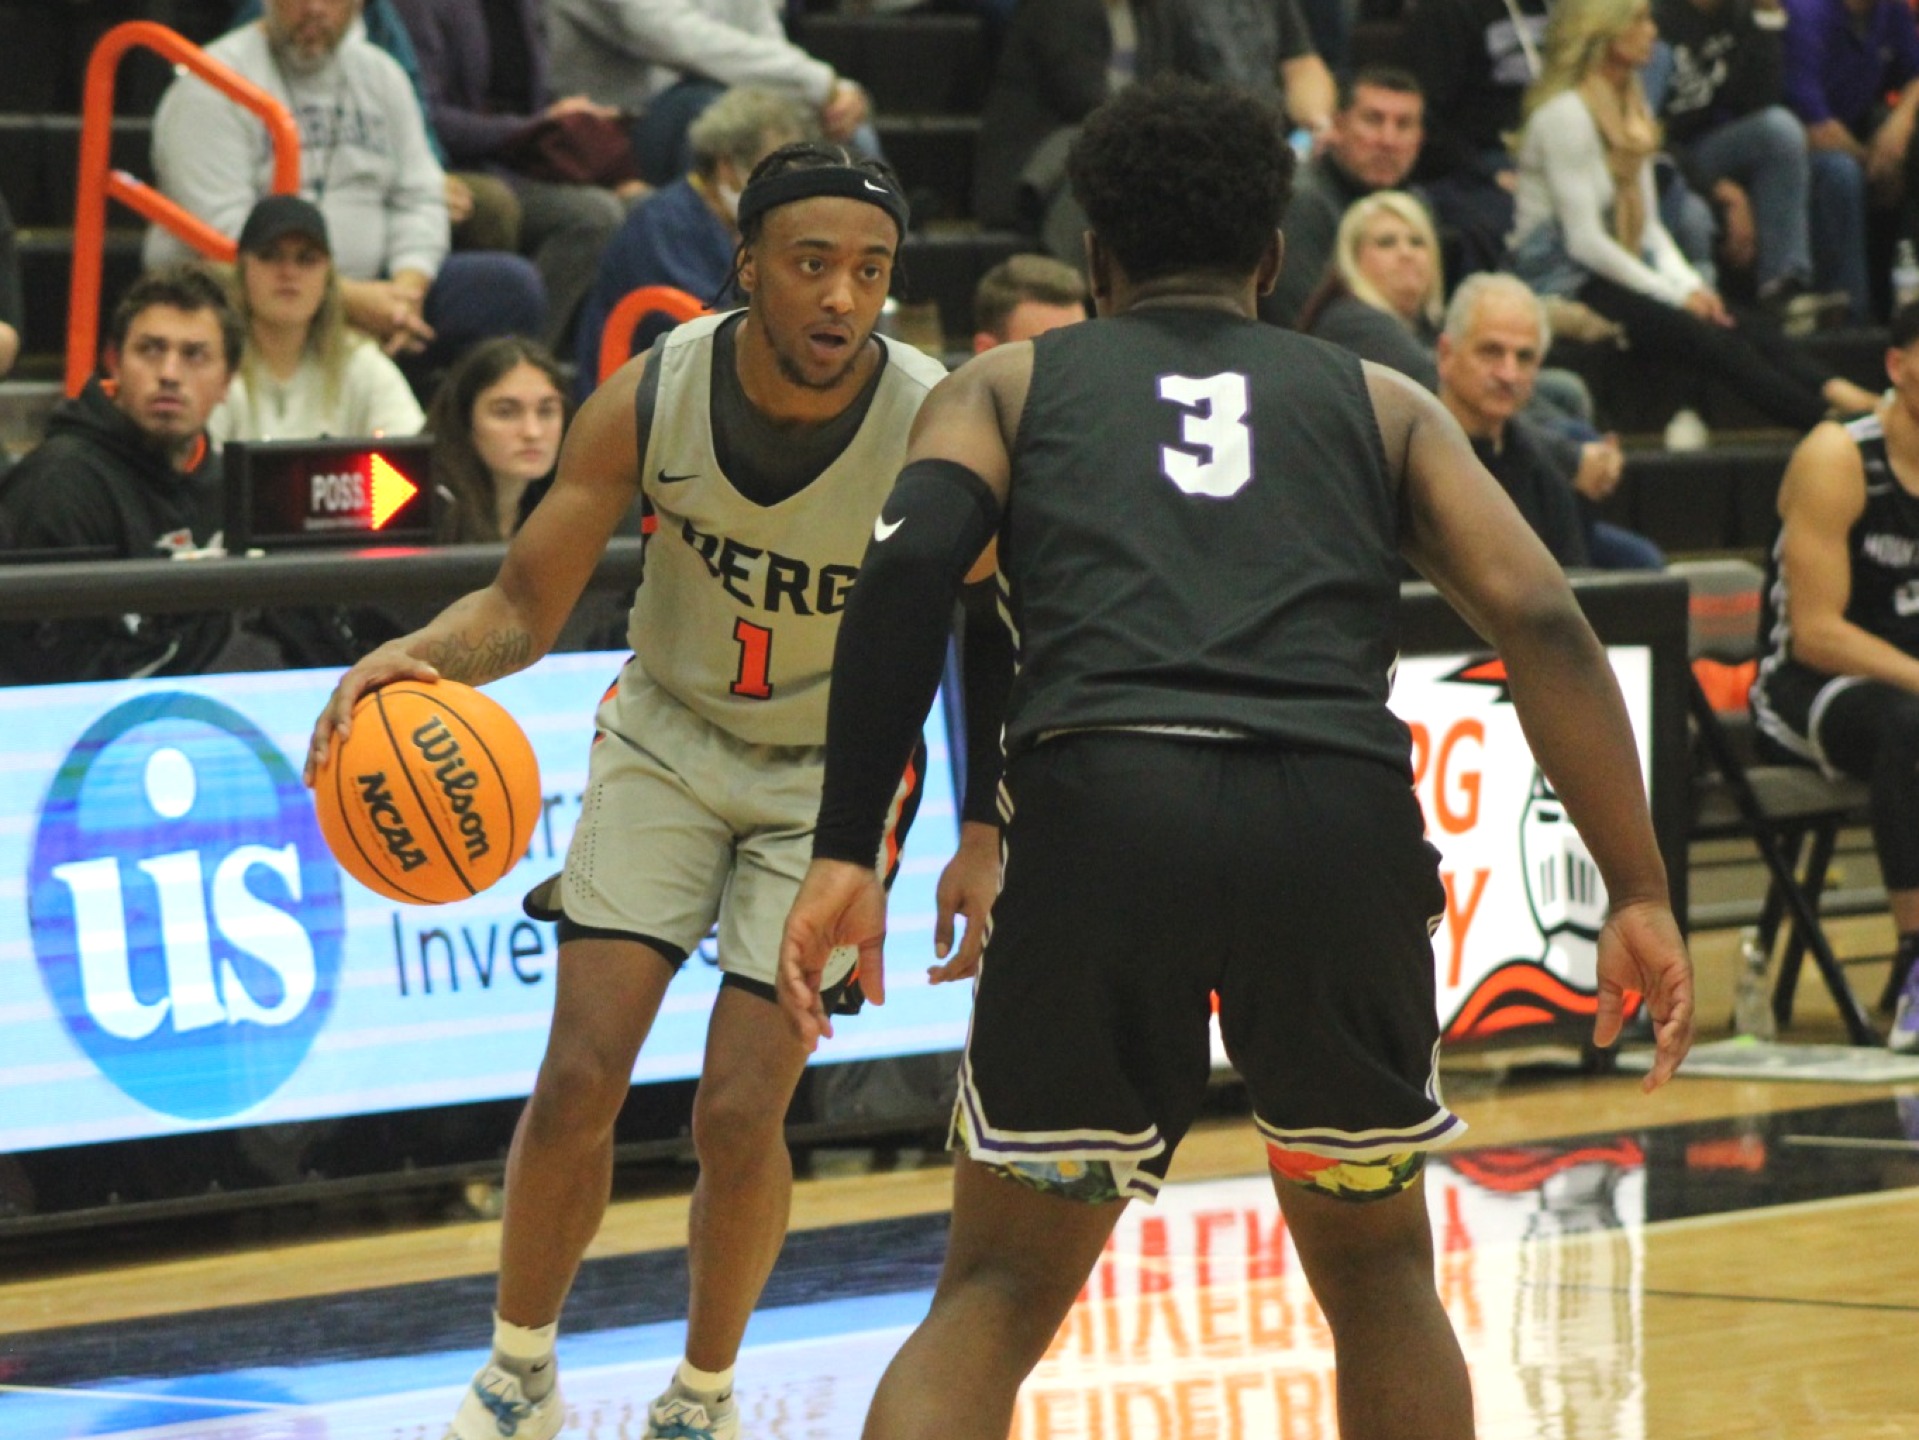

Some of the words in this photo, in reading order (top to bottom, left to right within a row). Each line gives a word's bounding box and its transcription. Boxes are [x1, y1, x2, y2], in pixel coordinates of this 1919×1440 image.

[1156, 371, 1254, 498] 3
[311, 472, 366, 512] POSS
[730, 616, 773, 700] 1
[357, 771, 430, 873] NCAA
[411, 715, 490, 862] Wilson
[392, 911, 560, 997] Inve
